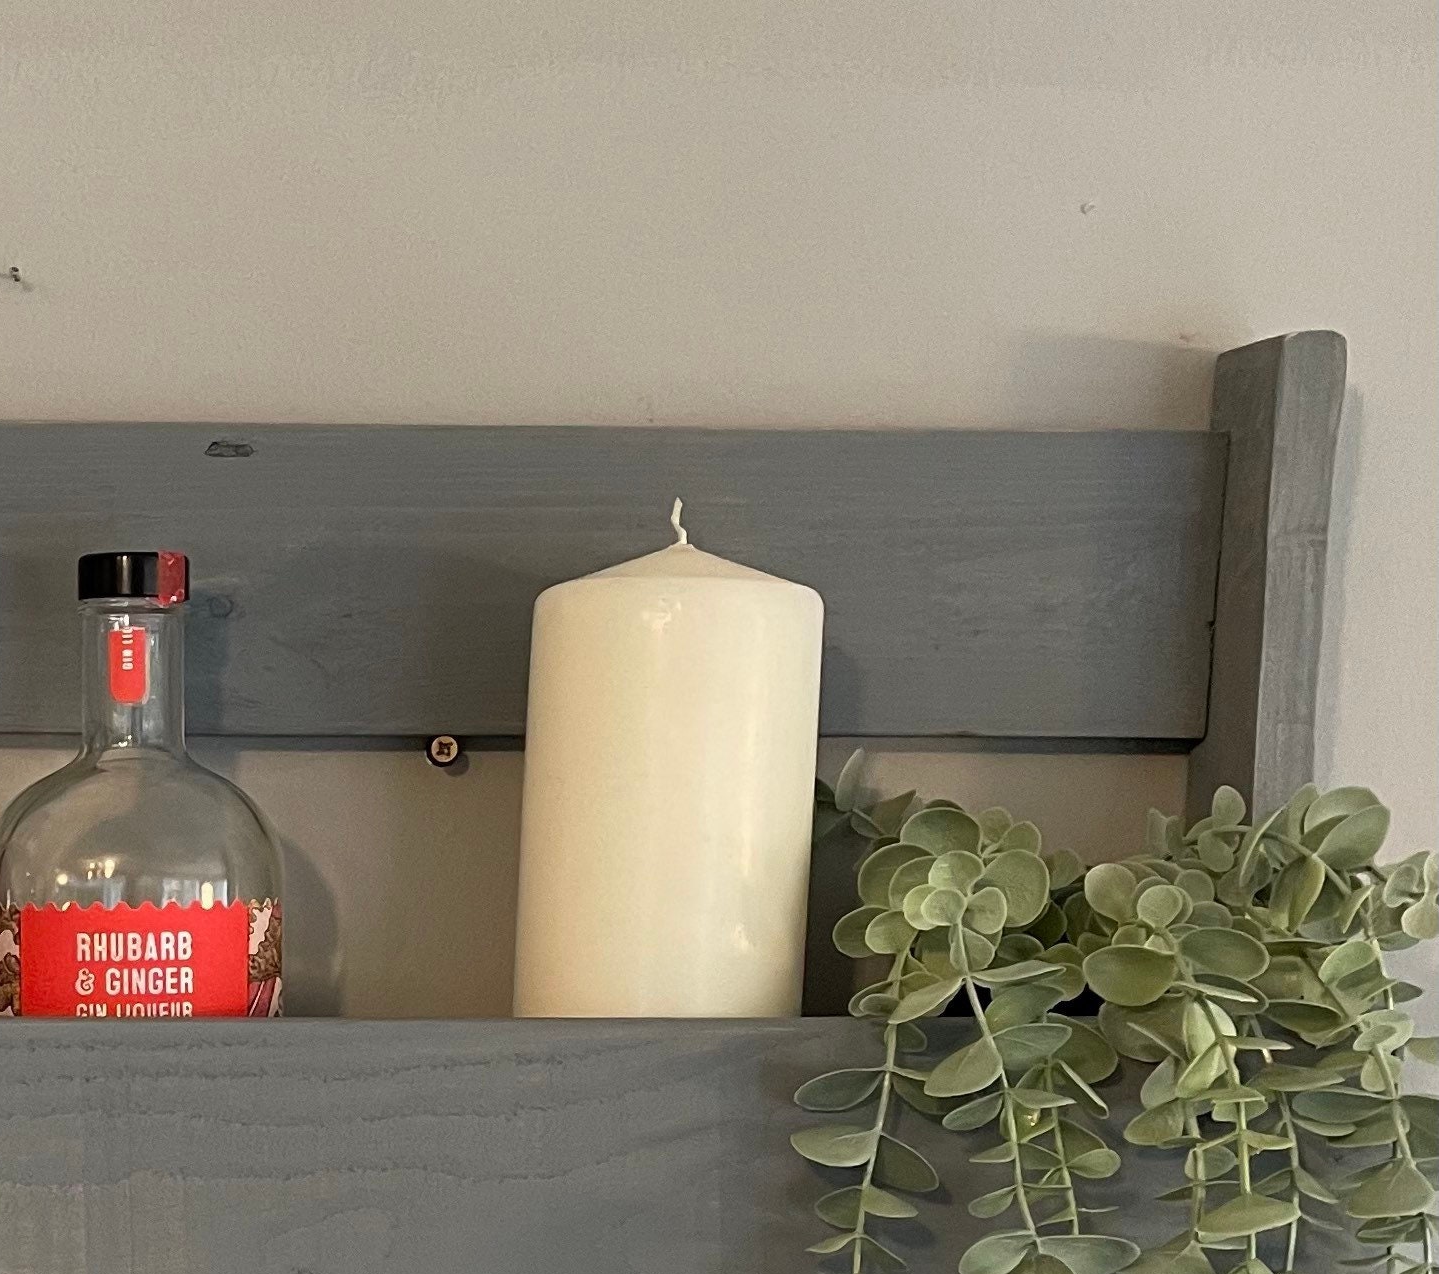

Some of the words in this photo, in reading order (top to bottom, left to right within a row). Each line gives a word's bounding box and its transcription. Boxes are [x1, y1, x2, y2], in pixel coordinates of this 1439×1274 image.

[76, 931, 193, 962] RHUBARB
[75, 968, 95, 996] &
[105, 967, 194, 996] GINGER
